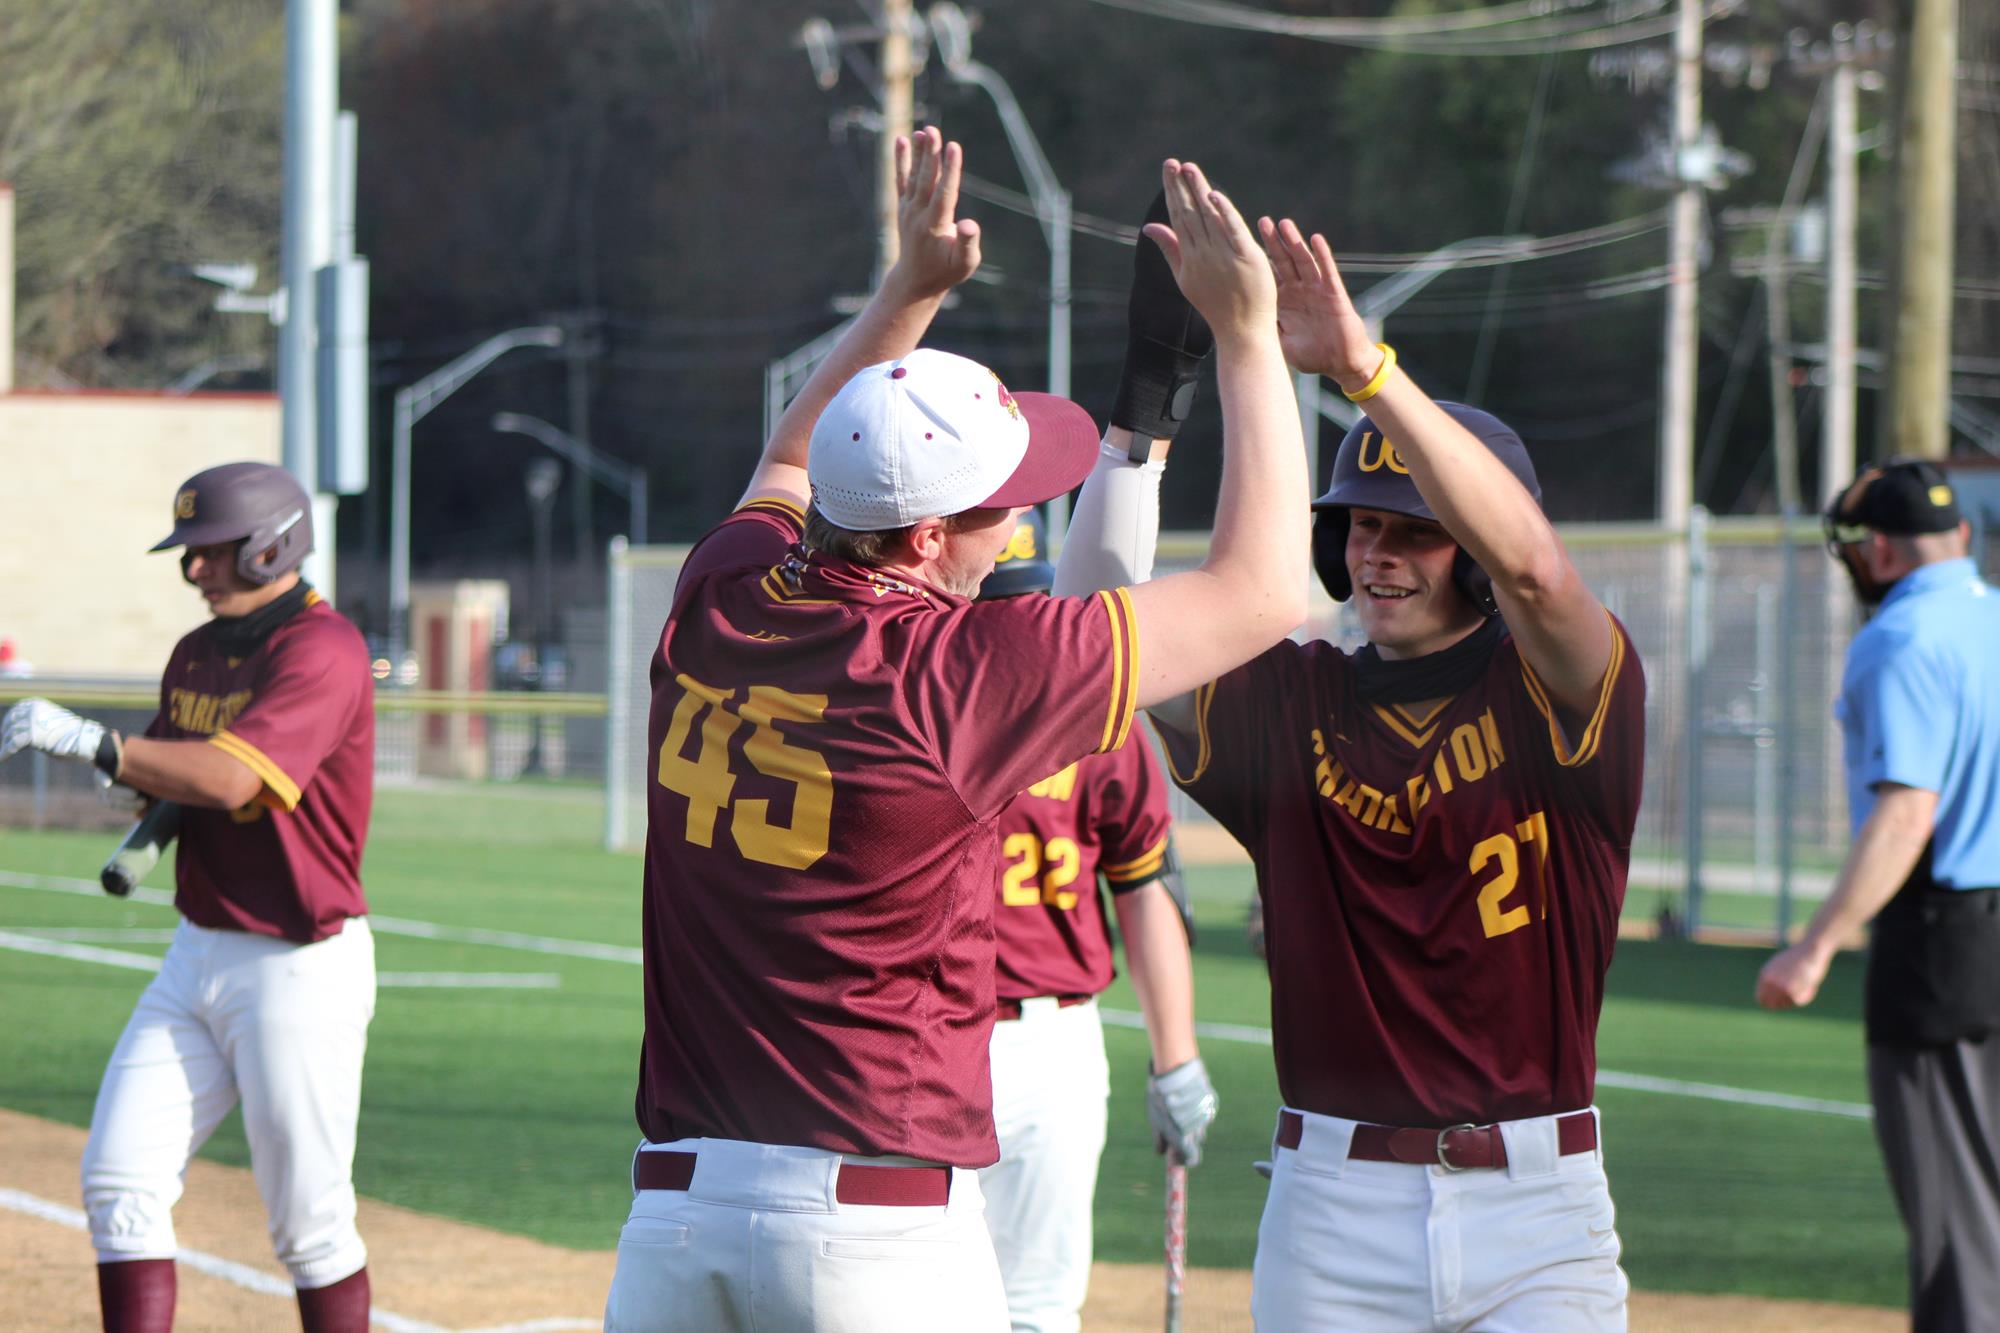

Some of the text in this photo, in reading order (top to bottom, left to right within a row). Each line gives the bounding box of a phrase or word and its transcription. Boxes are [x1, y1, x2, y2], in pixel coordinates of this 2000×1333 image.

[658, 673, 833, 870] 45
[1003, 833, 1080, 910] 22
[1469, 811, 1549, 938] 27
